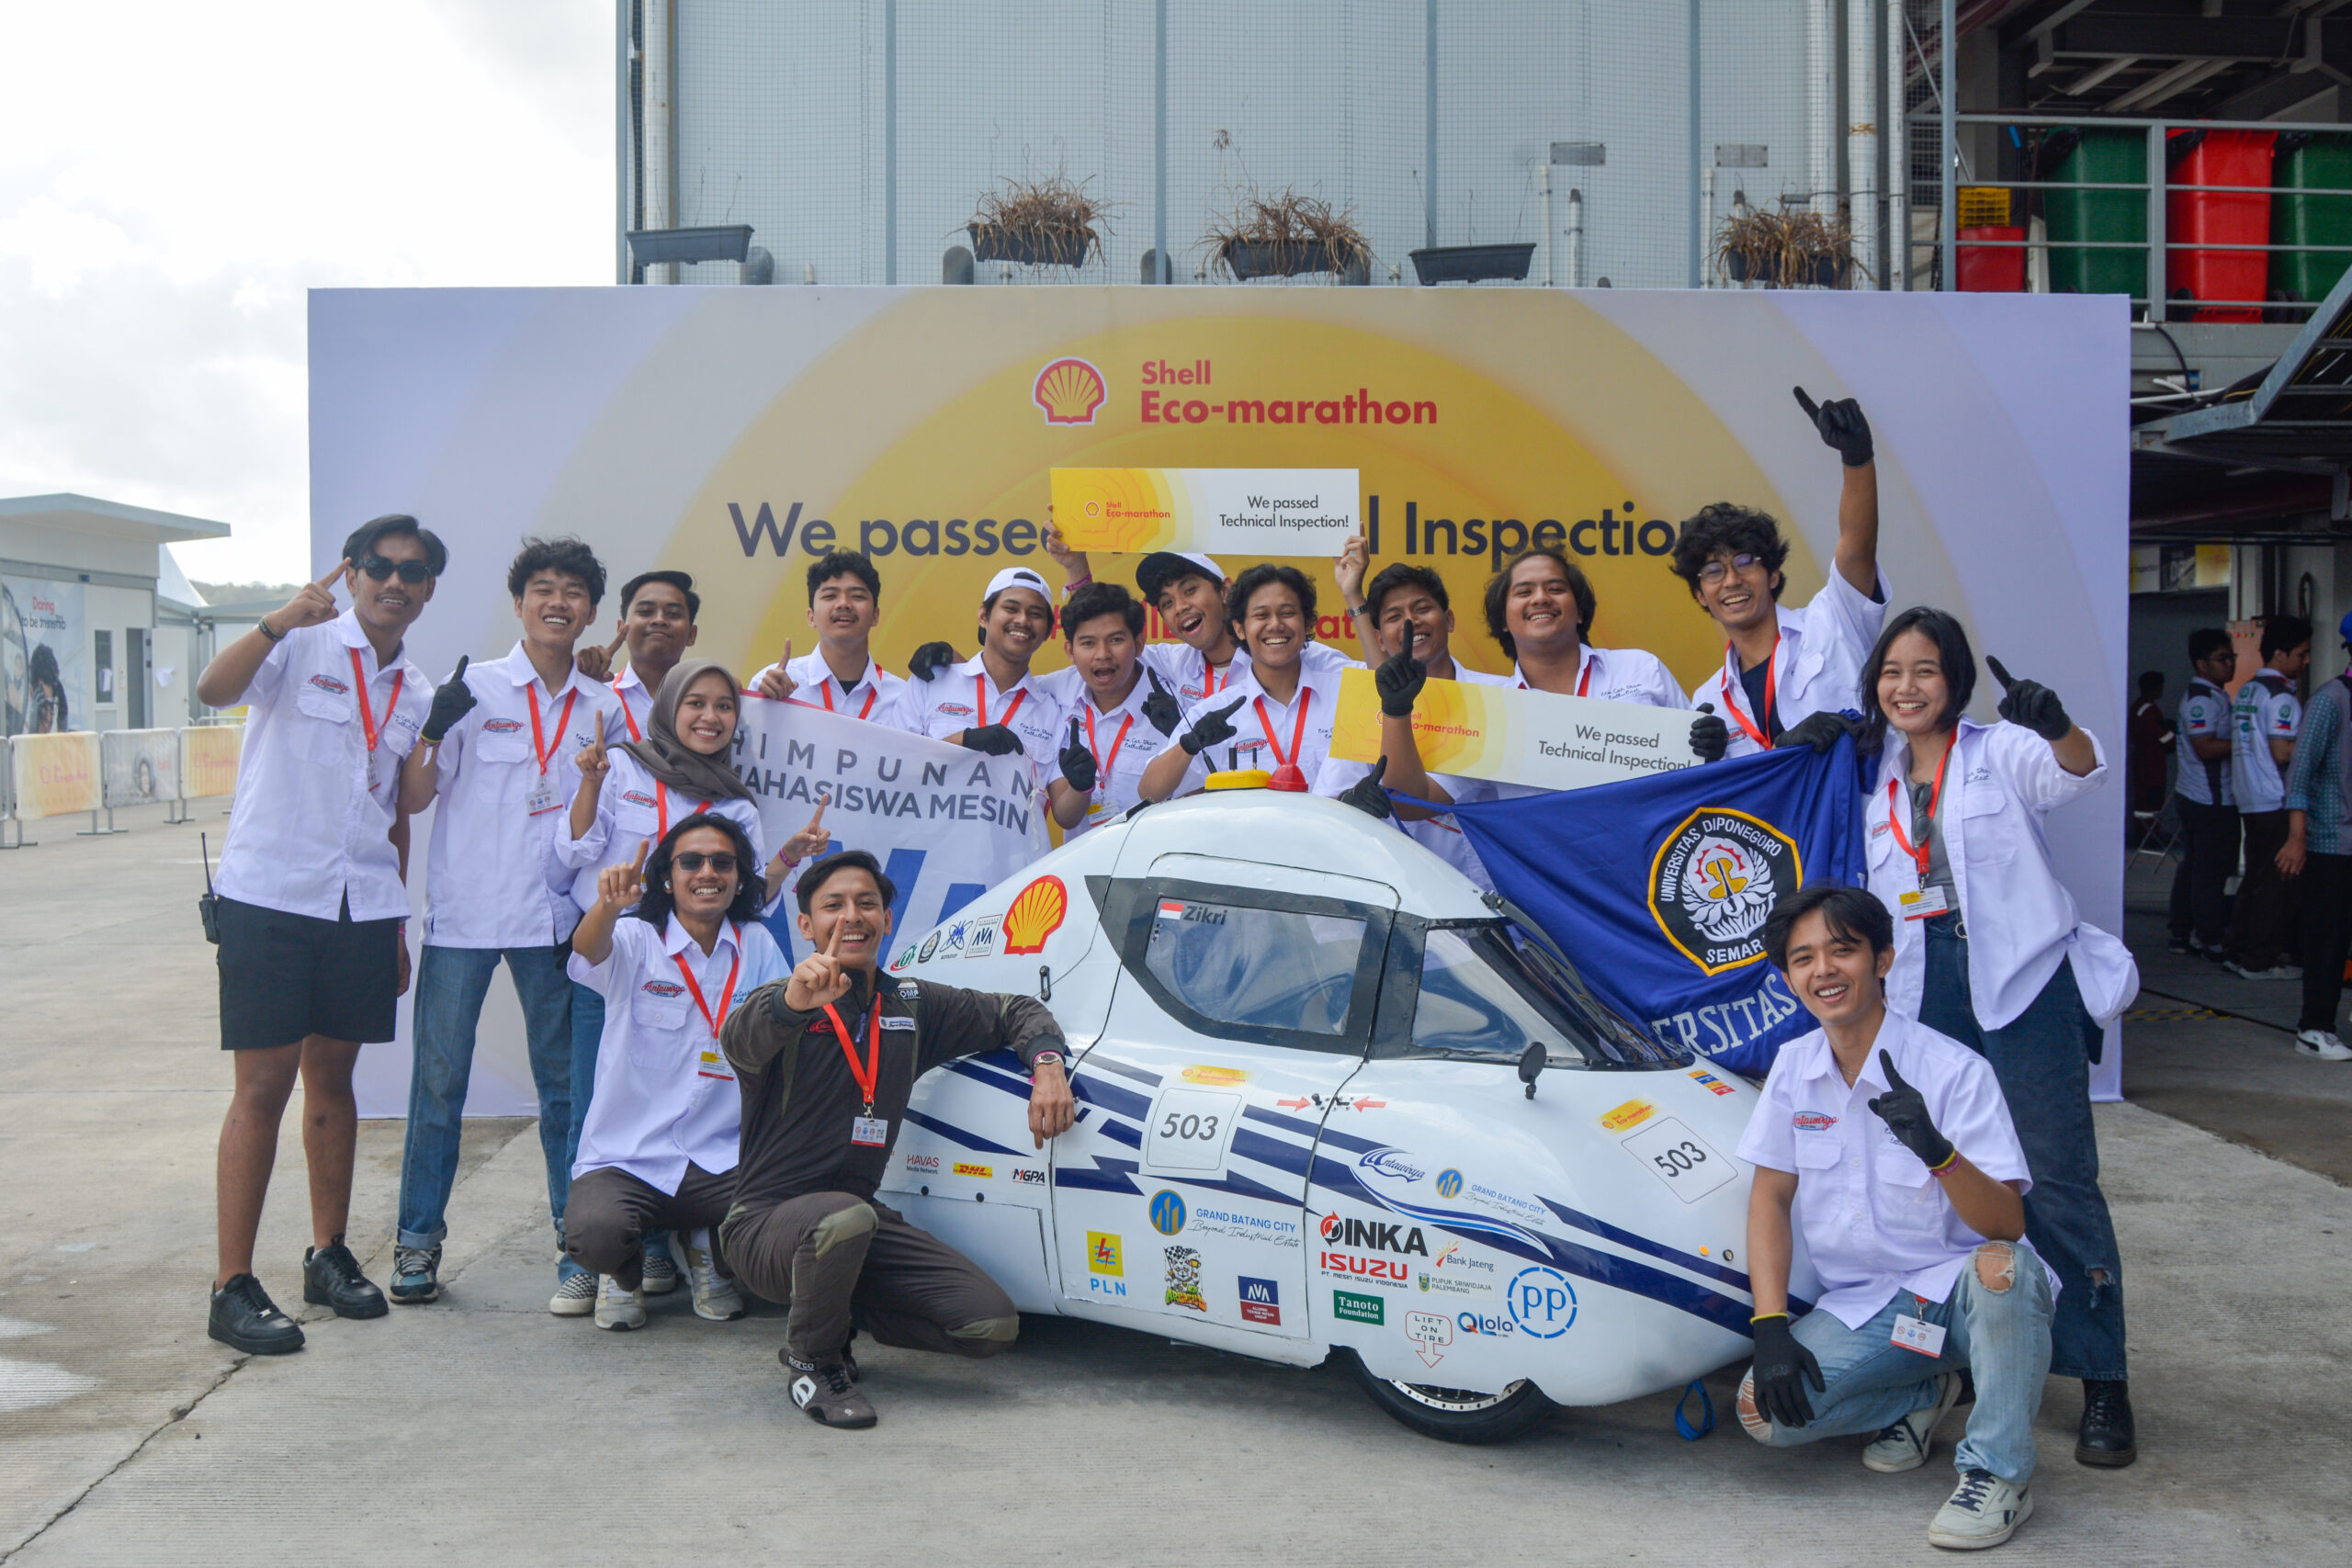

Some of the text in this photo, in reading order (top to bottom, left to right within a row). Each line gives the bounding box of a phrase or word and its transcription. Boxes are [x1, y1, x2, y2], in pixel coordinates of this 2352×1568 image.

[1141, 360, 1211, 385] Shell
[1141, 389, 1438, 424] Eco-marathon
[1247, 495, 1318, 512] We passed
[1106, 509, 1170, 519] Eco-marathon
[1219, 513, 1349, 531] Technical Inspection!
[727, 502, 1053, 558] We passe
[1406, 501, 1687, 572] Inspectio
[1412, 723, 1480, 738] o-marathon
[1576, 724, 1660, 749] We passed
[731, 730, 1032, 799] HIMPUNAN
[1539, 740, 1691, 772] Technical Inspection!
[930, 794, 1028, 836] MESIN
[1660, 817, 1782, 902] UNIVERSITAS DIPONEGORO
[1182, 906, 1228, 926] Zikri
[1706, 934, 1766, 964] SEMAR
[898, 988, 920, 998] OMP
[1159, 1113, 1219, 1141] 503
[907, 1154, 940, 1168] HAVAS
[1654, 1141, 1707, 1178] 503
[920, 1167, 938, 1175] Network
[958, 1165, 988, 1177] DHL
[1471, 1184, 1546, 1215] GRAND BATANG CITY
[1196, 1208, 1296, 1234] GRAND BATANG CITY
[1186, 1219, 1301, 1248] Beyond Industrial Estate
[1345, 1218, 1430, 1258] INKA
[1321, 1251, 1408, 1280] ISUZU
[1446, 1254, 1494, 1272] Bank Jateng
[1090, 1278, 1127, 1297] PLN
[1431, 1277, 1492, 1291] PUPUK SRIWIDJAJA
[1431, 1283, 1470, 1294] PALEMBANG
[1339, 1296, 1379, 1312] Tanoto
[1339, 1307, 1379, 1320] Foundation
[1415, 1314, 1443, 1325] LIFT
[1420, 1325, 1438, 1334] ON
[1415, 1332, 1444, 1344] TIRE
